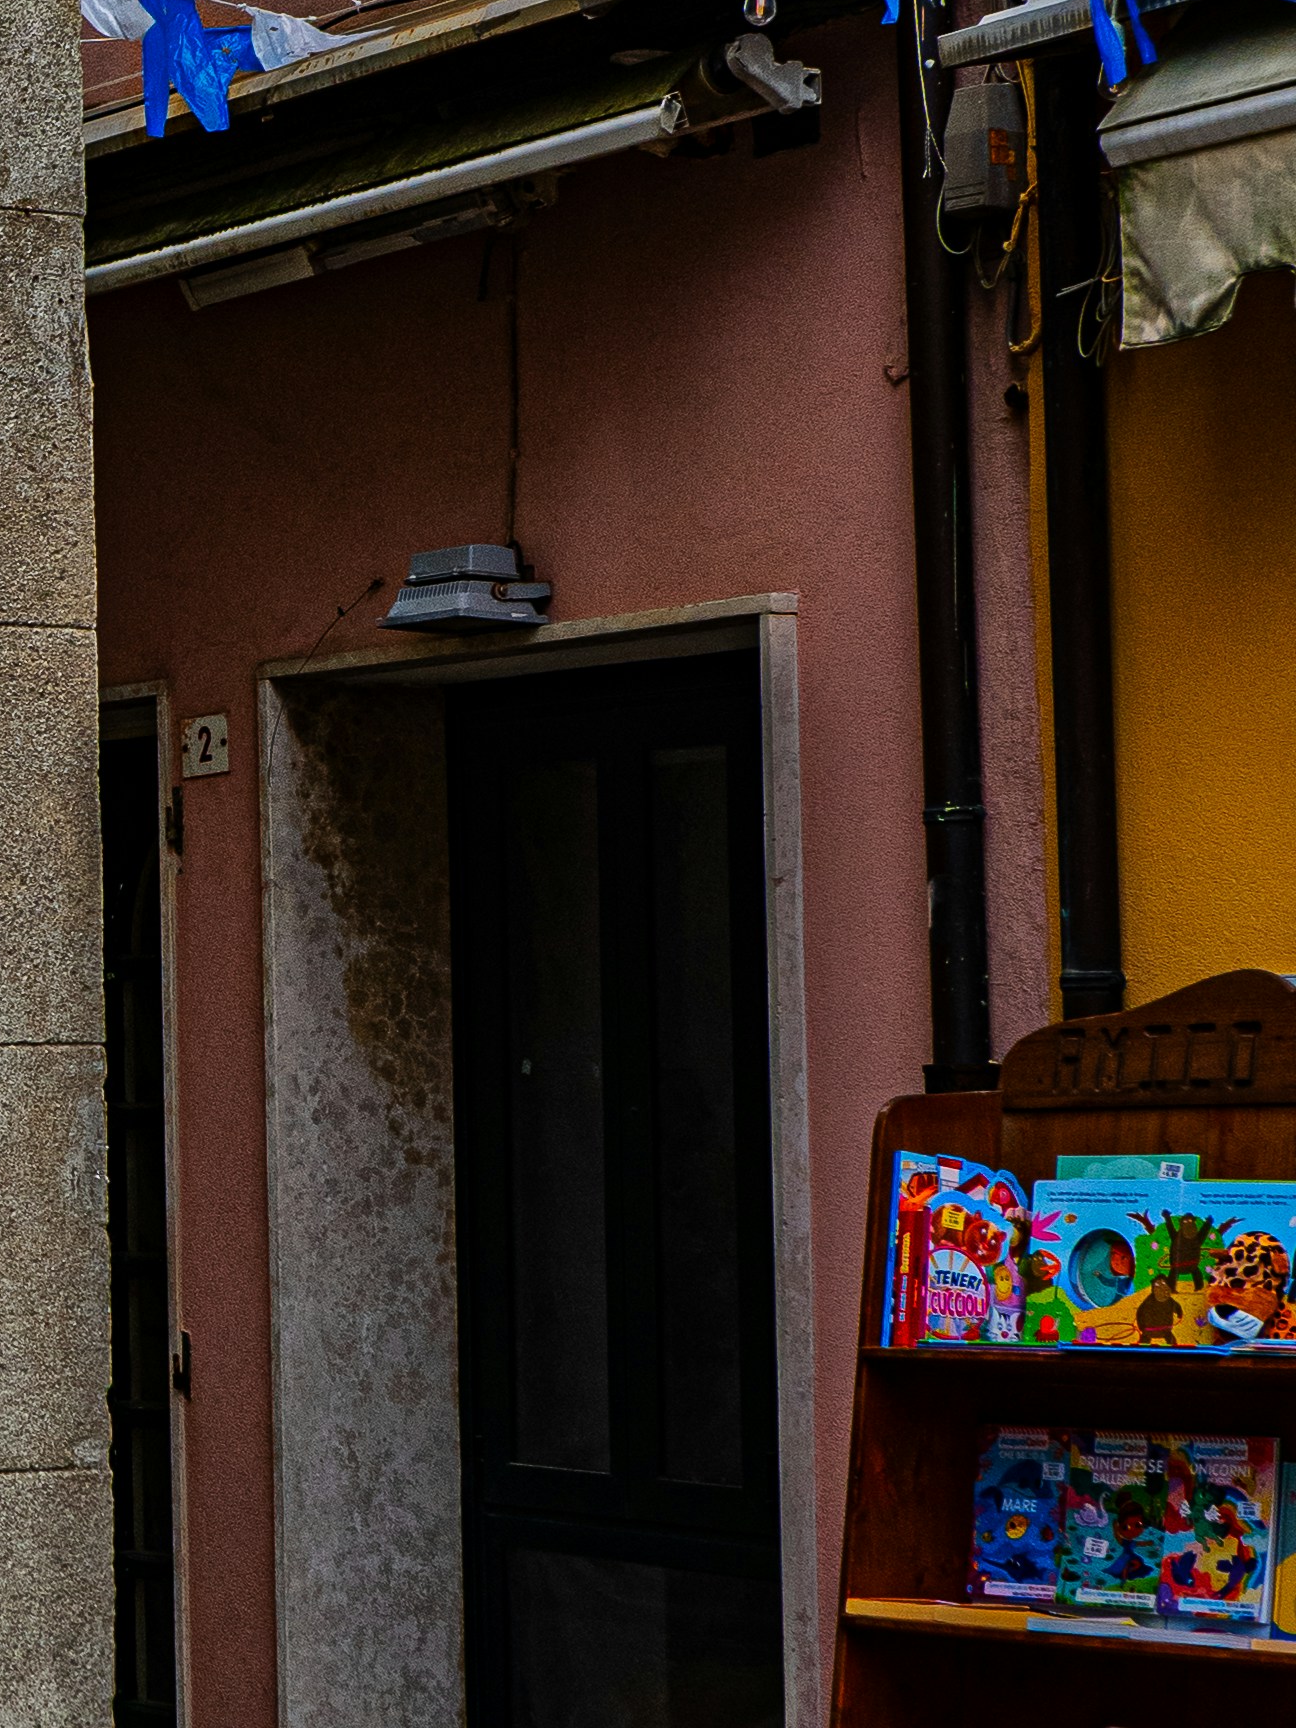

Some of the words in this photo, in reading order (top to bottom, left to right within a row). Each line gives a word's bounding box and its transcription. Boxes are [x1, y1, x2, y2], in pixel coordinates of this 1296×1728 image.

[197, 725, 213, 763] 2
[934, 1269, 982, 1291] TENERI
[930, 1290, 986, 1317] CUCCIOLI
[1078, 1455, 1164, 1474] PRINCIPESSE
[1001, 1498, 1038, 1513] MARE
